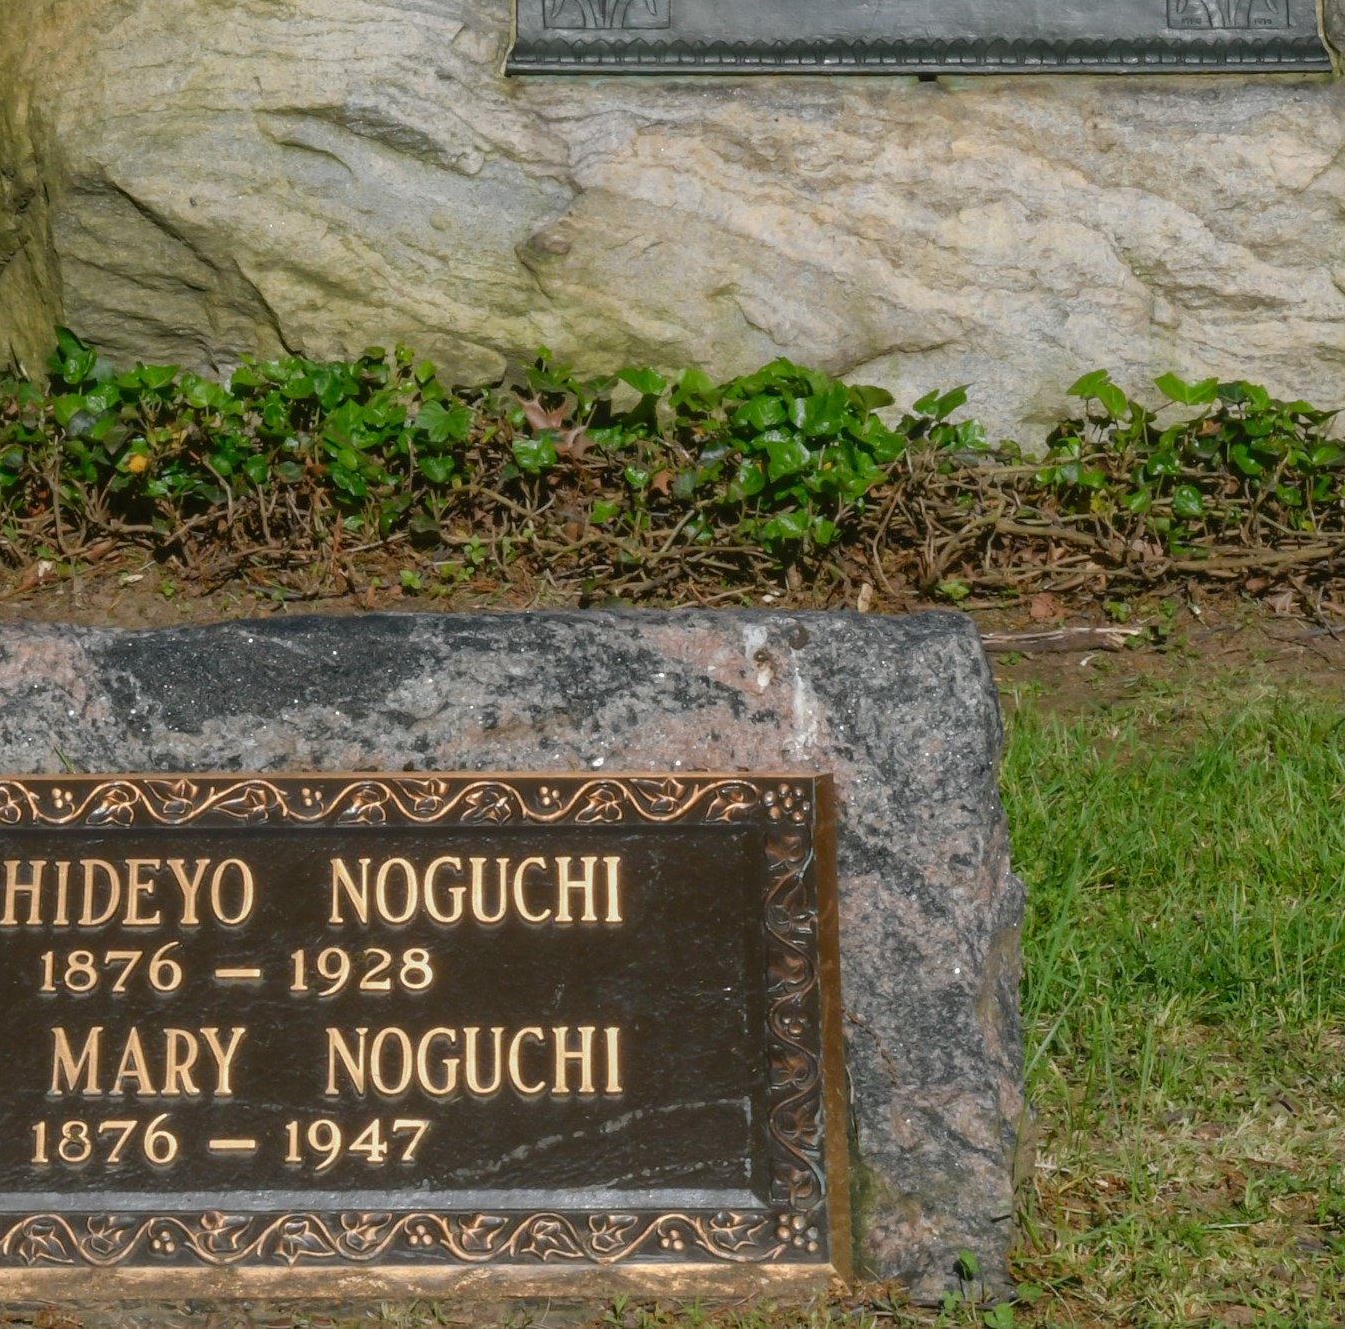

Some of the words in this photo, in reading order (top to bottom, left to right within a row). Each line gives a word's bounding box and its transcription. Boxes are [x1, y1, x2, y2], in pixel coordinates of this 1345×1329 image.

[0, 856, 255, 927] HIDEYO
[328, 855, 623, 925] NOGUCHI
[39, 940, 185, 994] 1876
[289, 947, 434, 997] 1928
[47, 1026, 246, 1097] MARY
[323, 1025, 622, 1097] NOGUCHI
[30, 1113, 181, 1167] 1876
[285, 1117, 431, 1171] 1947
